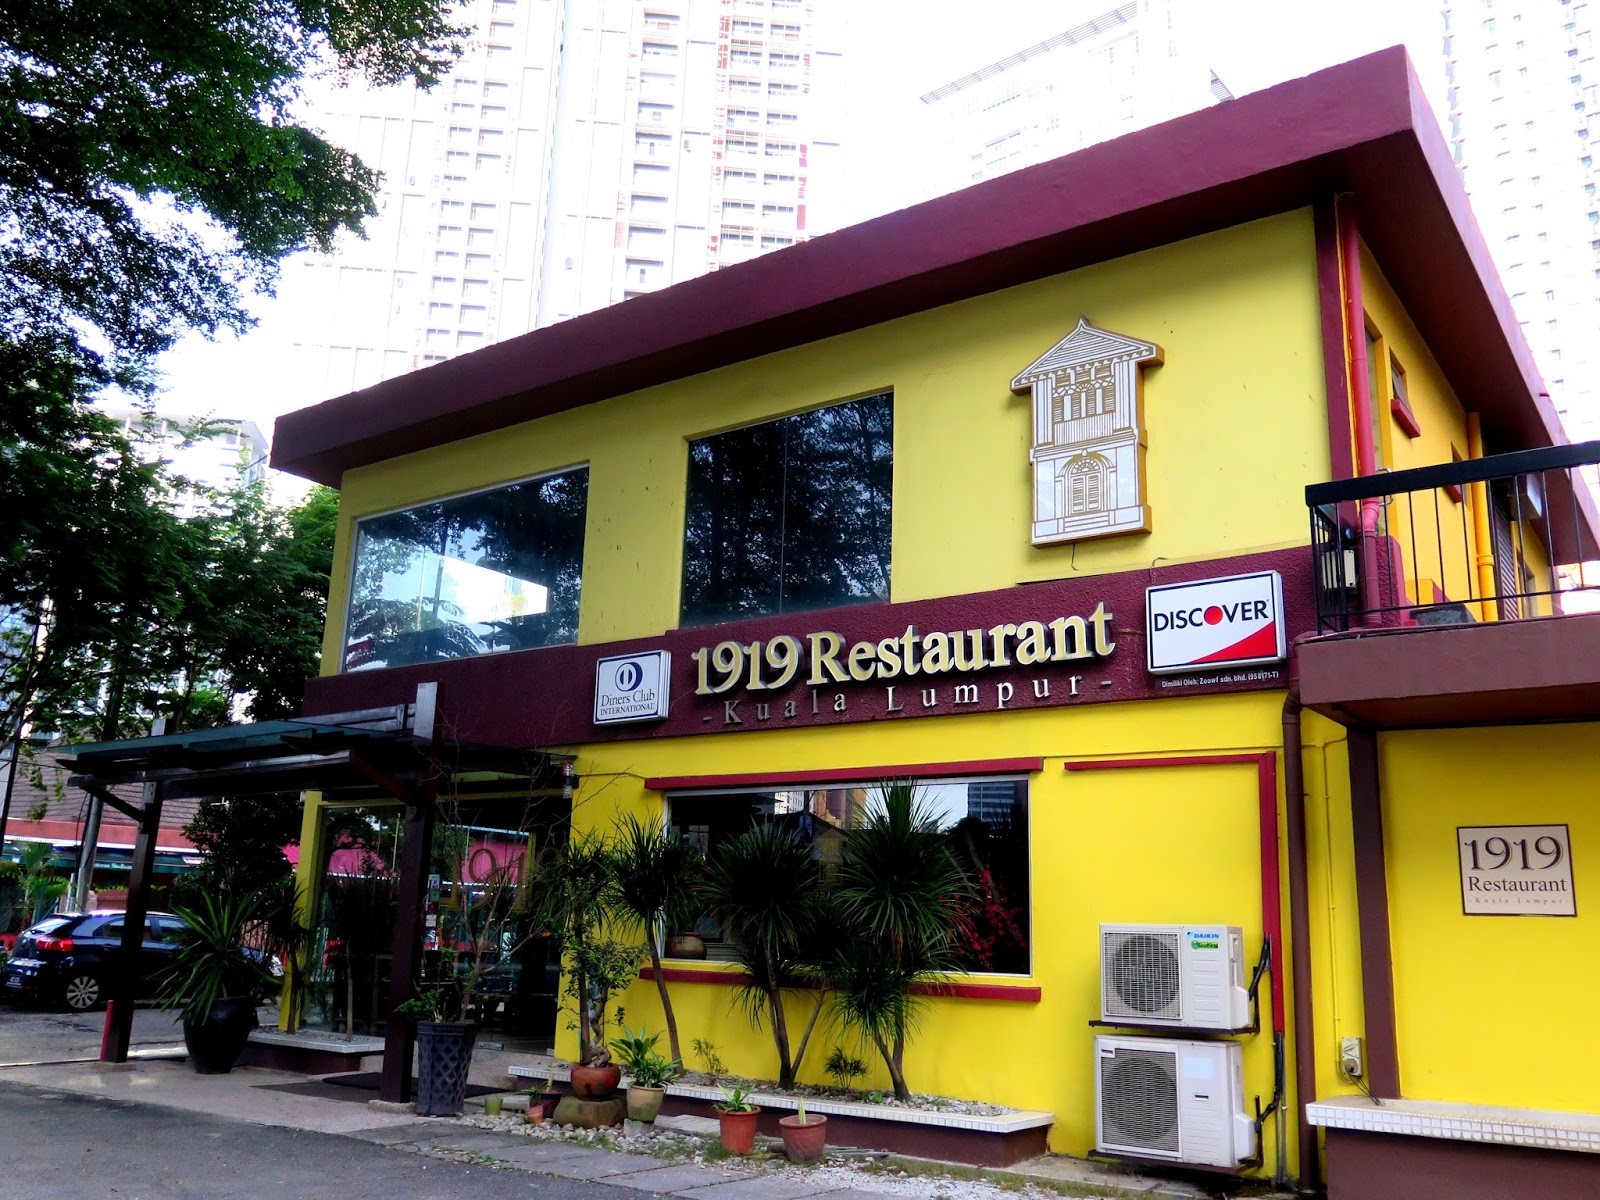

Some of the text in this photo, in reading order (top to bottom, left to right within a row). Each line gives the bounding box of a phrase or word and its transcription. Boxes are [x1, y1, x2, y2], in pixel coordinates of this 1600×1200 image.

[1154, 599, 1269, 632] DISCOVER
[691, 601, 1117, 696] 1919 Restaurant
[601, 703, 654, 715] INTERNATIONAL
[602, 689, 655, 707] Diners Club
[1464, 836, 1562, 870] 1919
[1468, 876, 1568, 892] Restaurant
